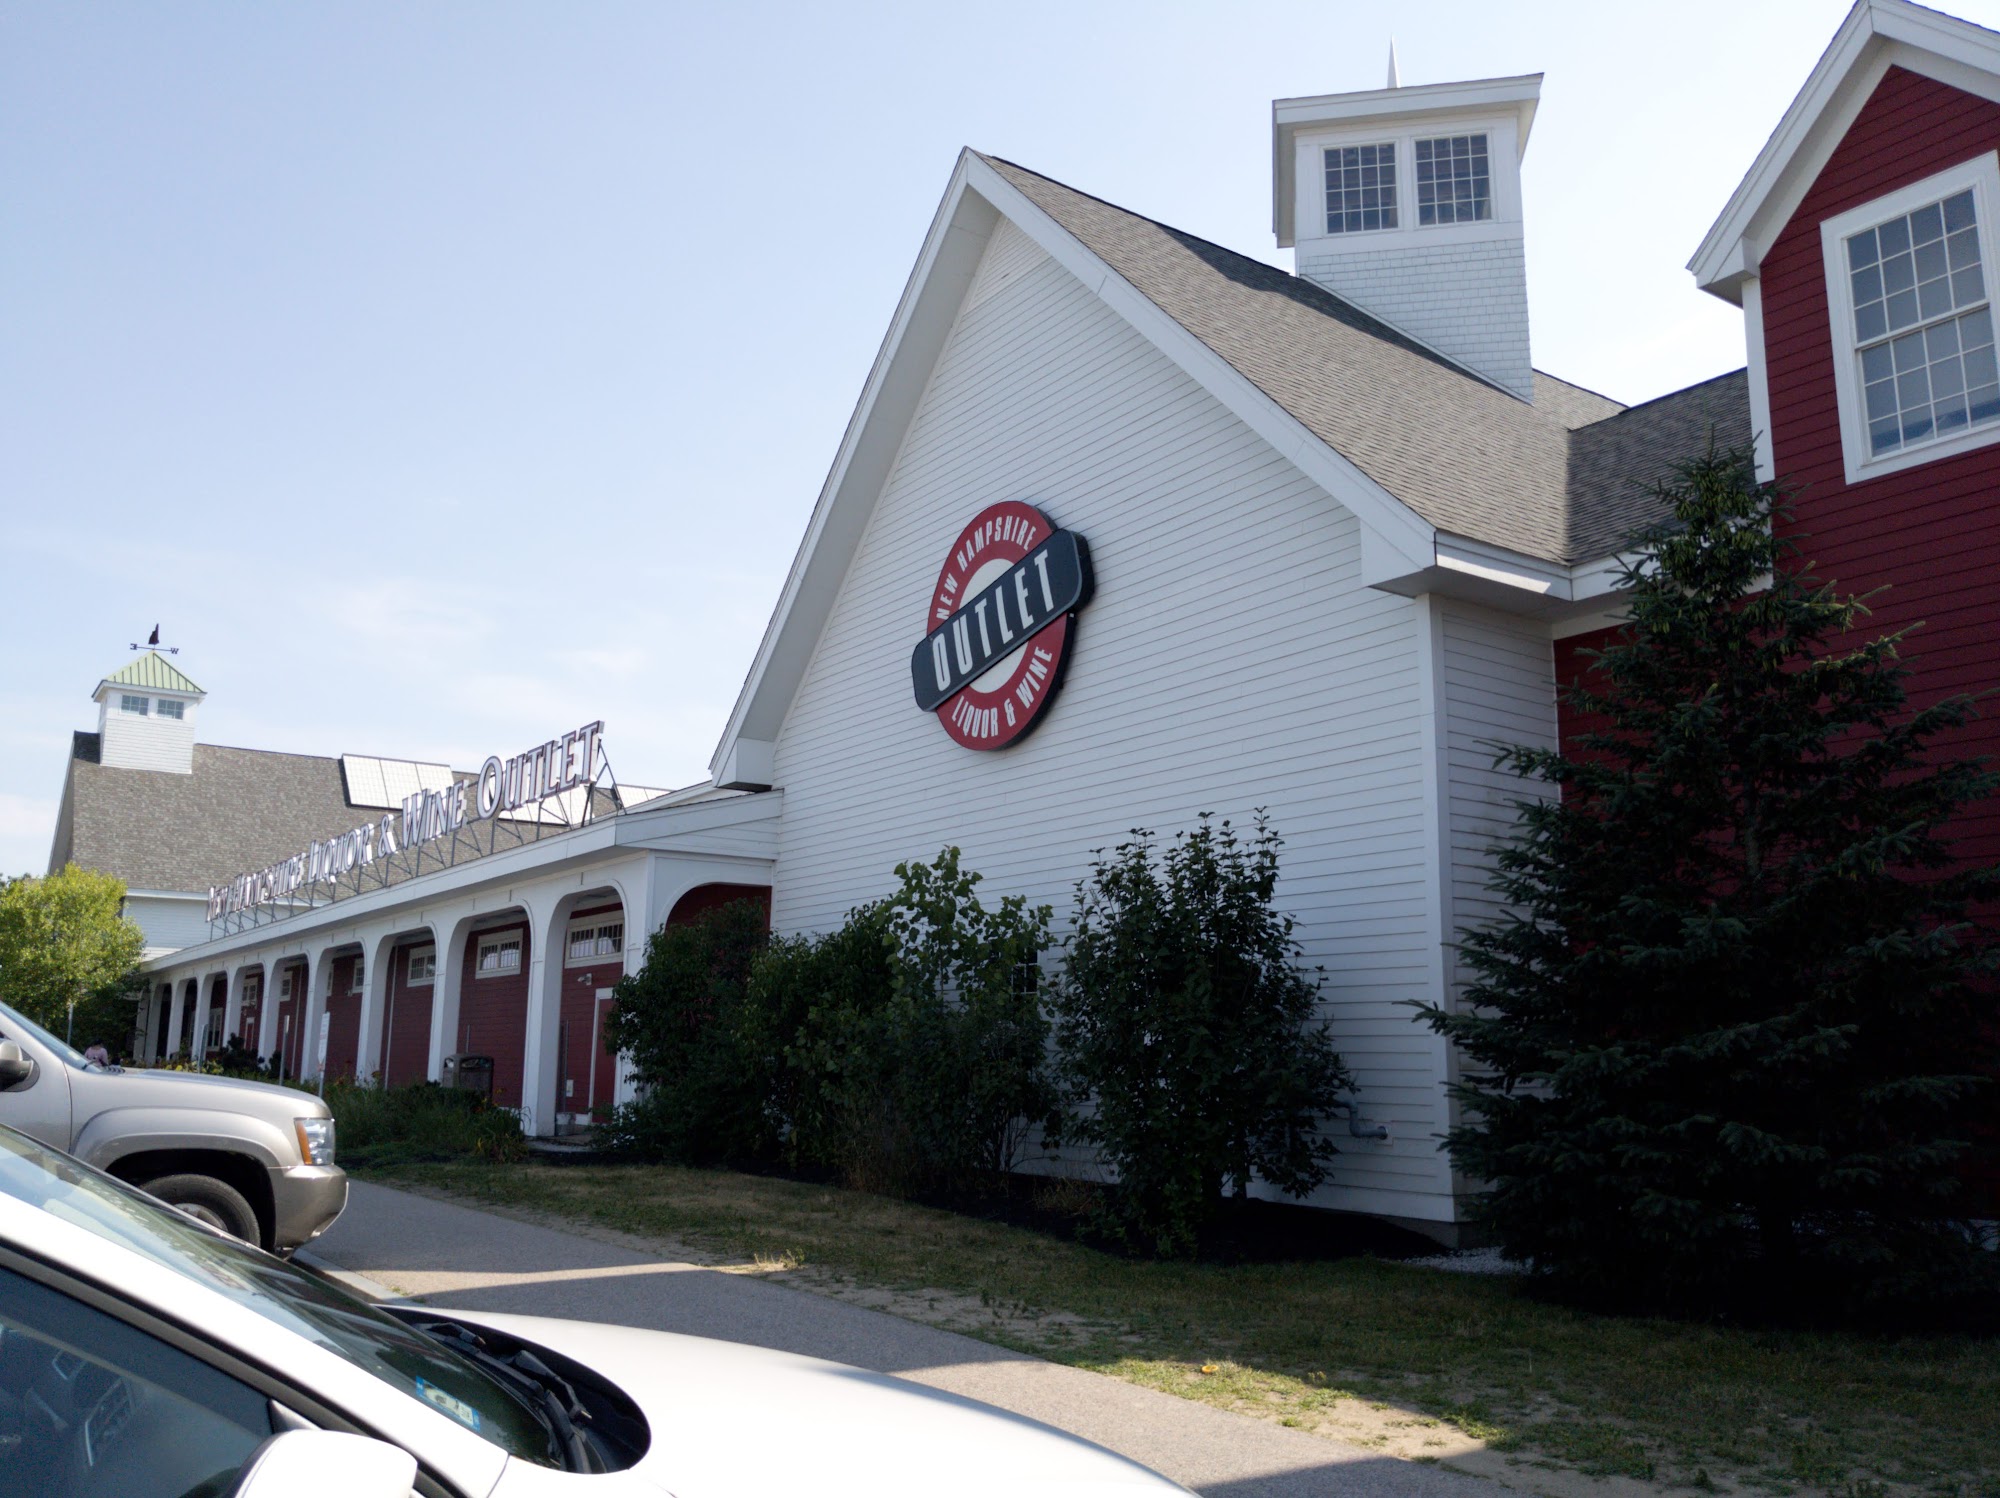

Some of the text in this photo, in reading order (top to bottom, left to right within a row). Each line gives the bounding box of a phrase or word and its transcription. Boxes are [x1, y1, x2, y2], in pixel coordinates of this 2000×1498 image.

[932, 549, 1054, 692] OUTLET
[936, 515, 1037, 620] NEW HAMPSHIRE
[951, 646, 1053, 739] LIQUOR & WINE
[378, 814, 397, 859] &
[402, 779, 468, 850] WINE
[477, 720, 604, 819] OUTLET
